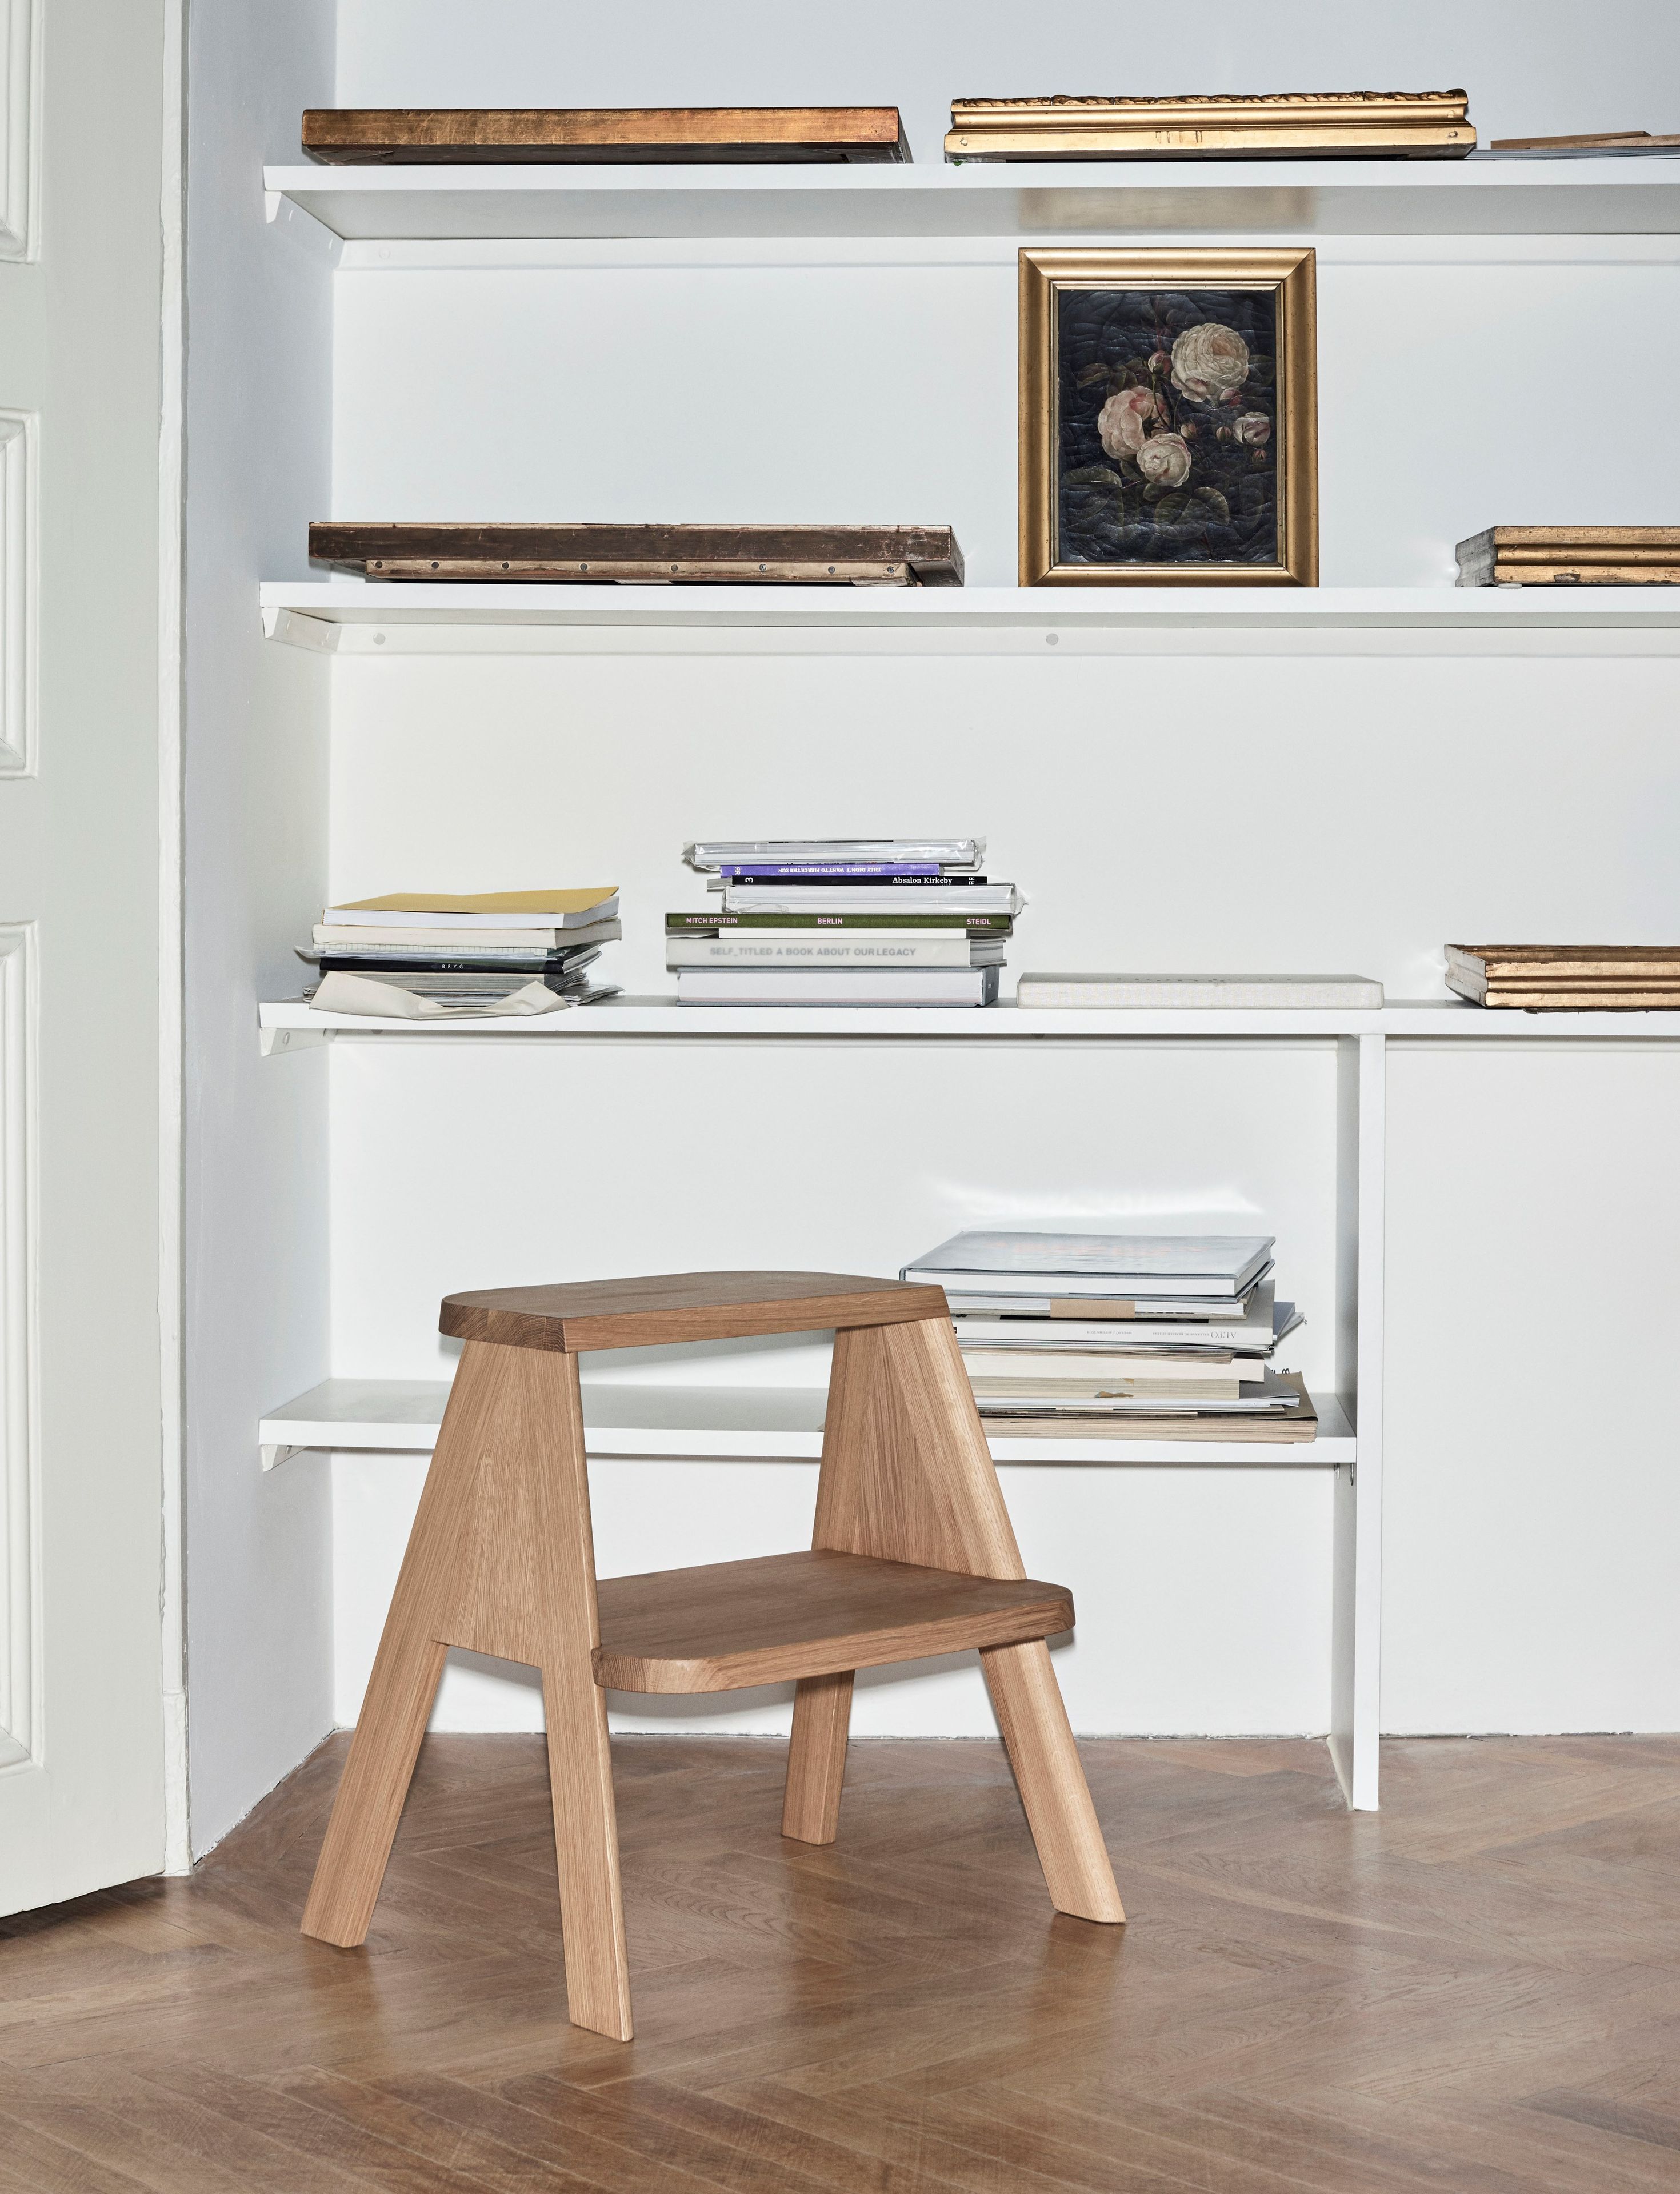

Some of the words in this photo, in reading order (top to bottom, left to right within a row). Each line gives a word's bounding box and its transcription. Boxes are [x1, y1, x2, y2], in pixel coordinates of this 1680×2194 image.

[710, 947, 773, 957] SELF_TITLED
[777, 947, 783, 956] A
[786, 947, 814, 956] BOOK
[817, 947, 851, 956] ABOUT
